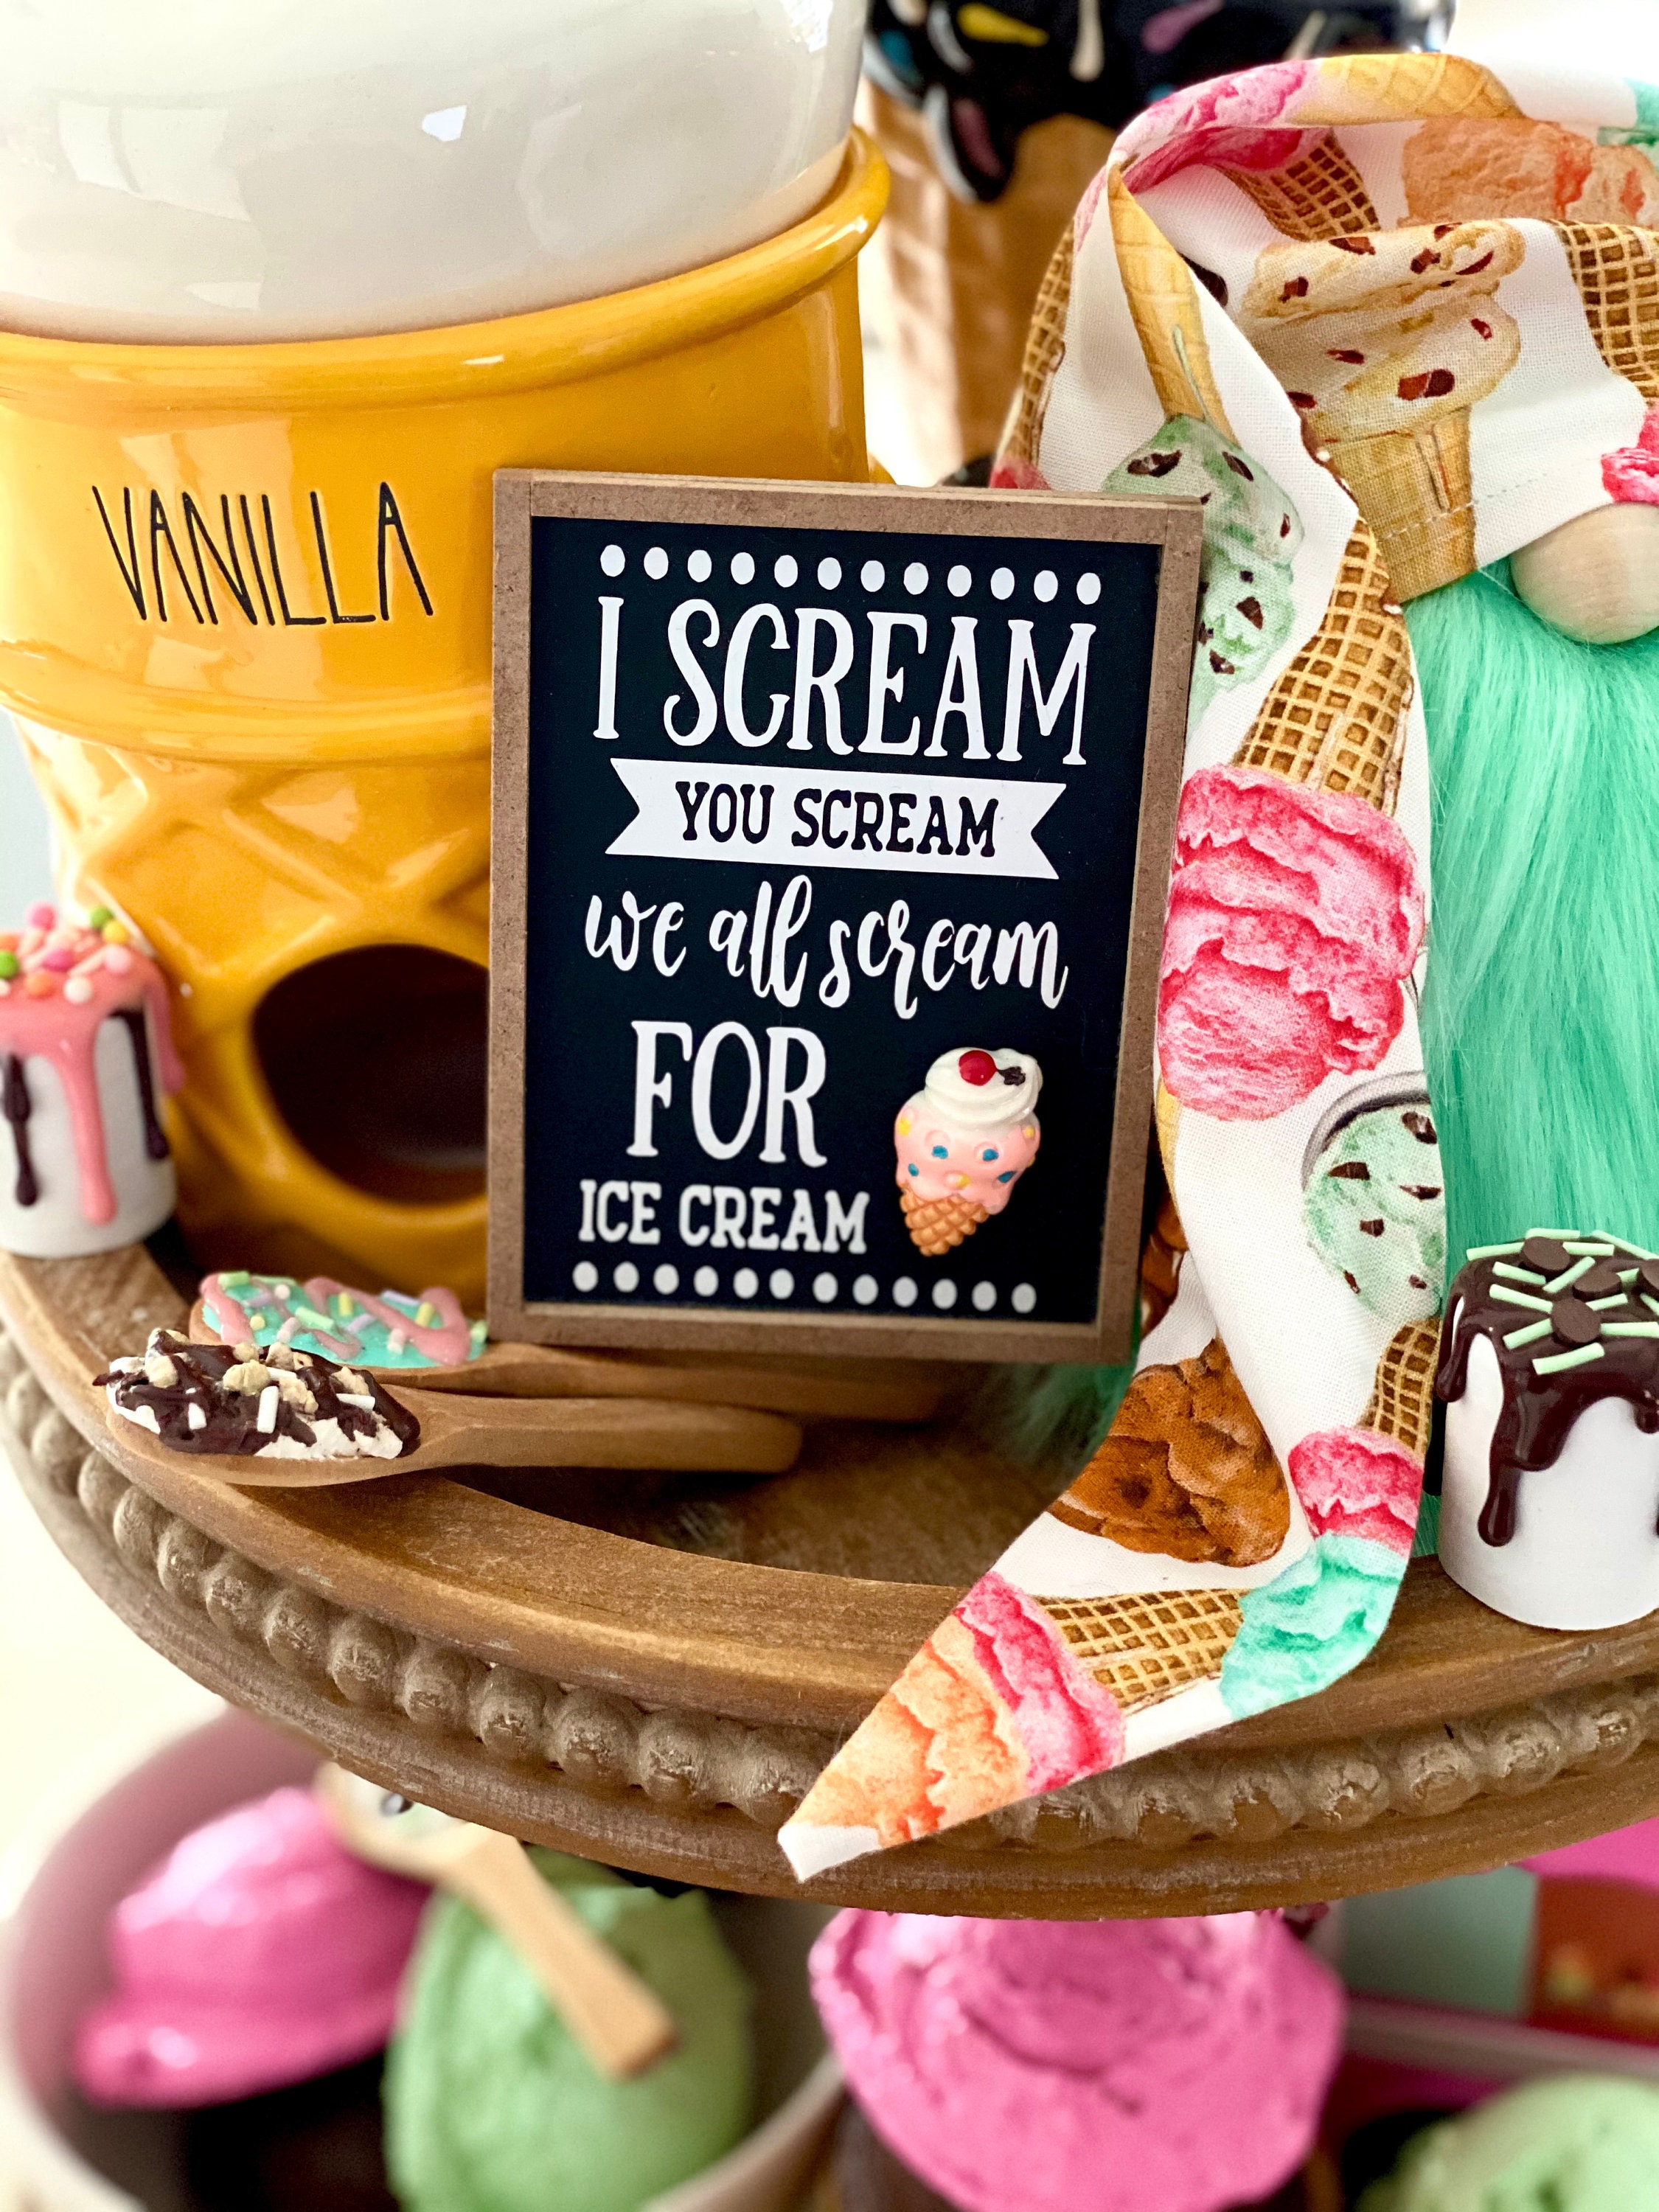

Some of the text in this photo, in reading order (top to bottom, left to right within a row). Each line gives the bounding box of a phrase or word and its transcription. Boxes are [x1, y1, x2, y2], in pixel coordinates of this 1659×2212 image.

[91, 481, 434, 626] VANILLA
[593, 596, 1097, 765] I SCREAM
[675, 781, 999, 858] YOU SCREAM
[585, 874, 1069, 1020] we all scream
[626, 1020, 827, 1167] FOR
[579, 1180, 869, 1253] ICE CREAM
